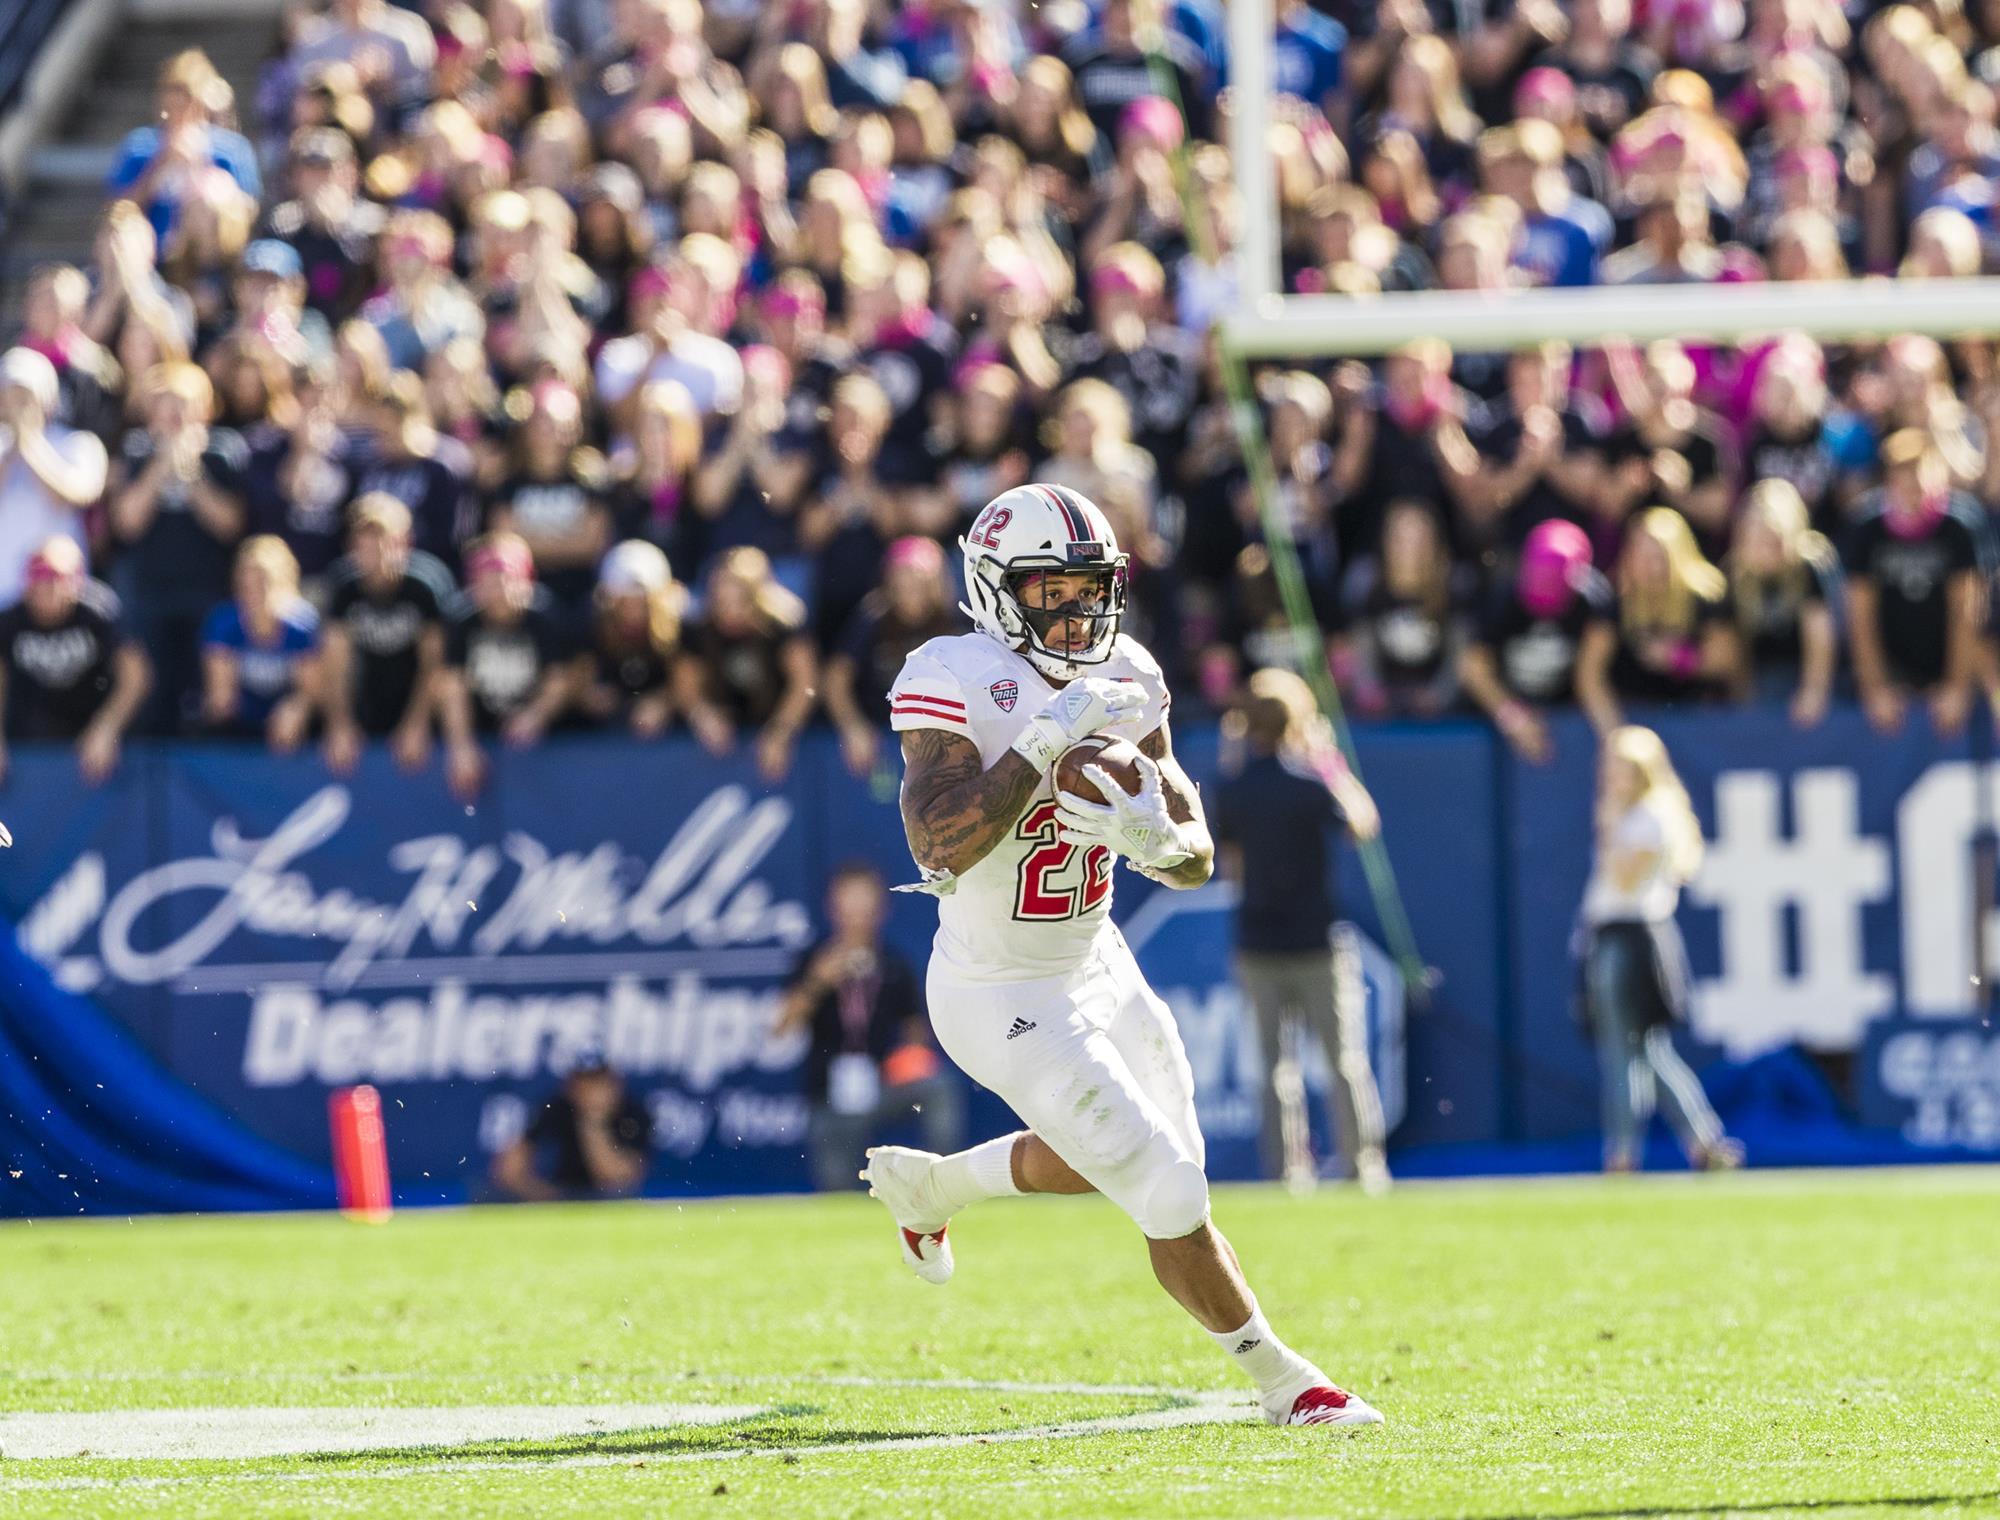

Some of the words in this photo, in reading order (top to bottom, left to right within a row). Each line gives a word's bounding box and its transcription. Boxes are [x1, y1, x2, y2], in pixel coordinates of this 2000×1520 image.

[971, 504, 1012, 550] 22
[1072, 544, 1100, 556] NIU
[992, 688, 1018, 700] MAC
[1012, 798, 1111, 922] 22
[242, 975, 812, 1090] Dealerships
[1006, 1021, 1037, 1040] adidas
